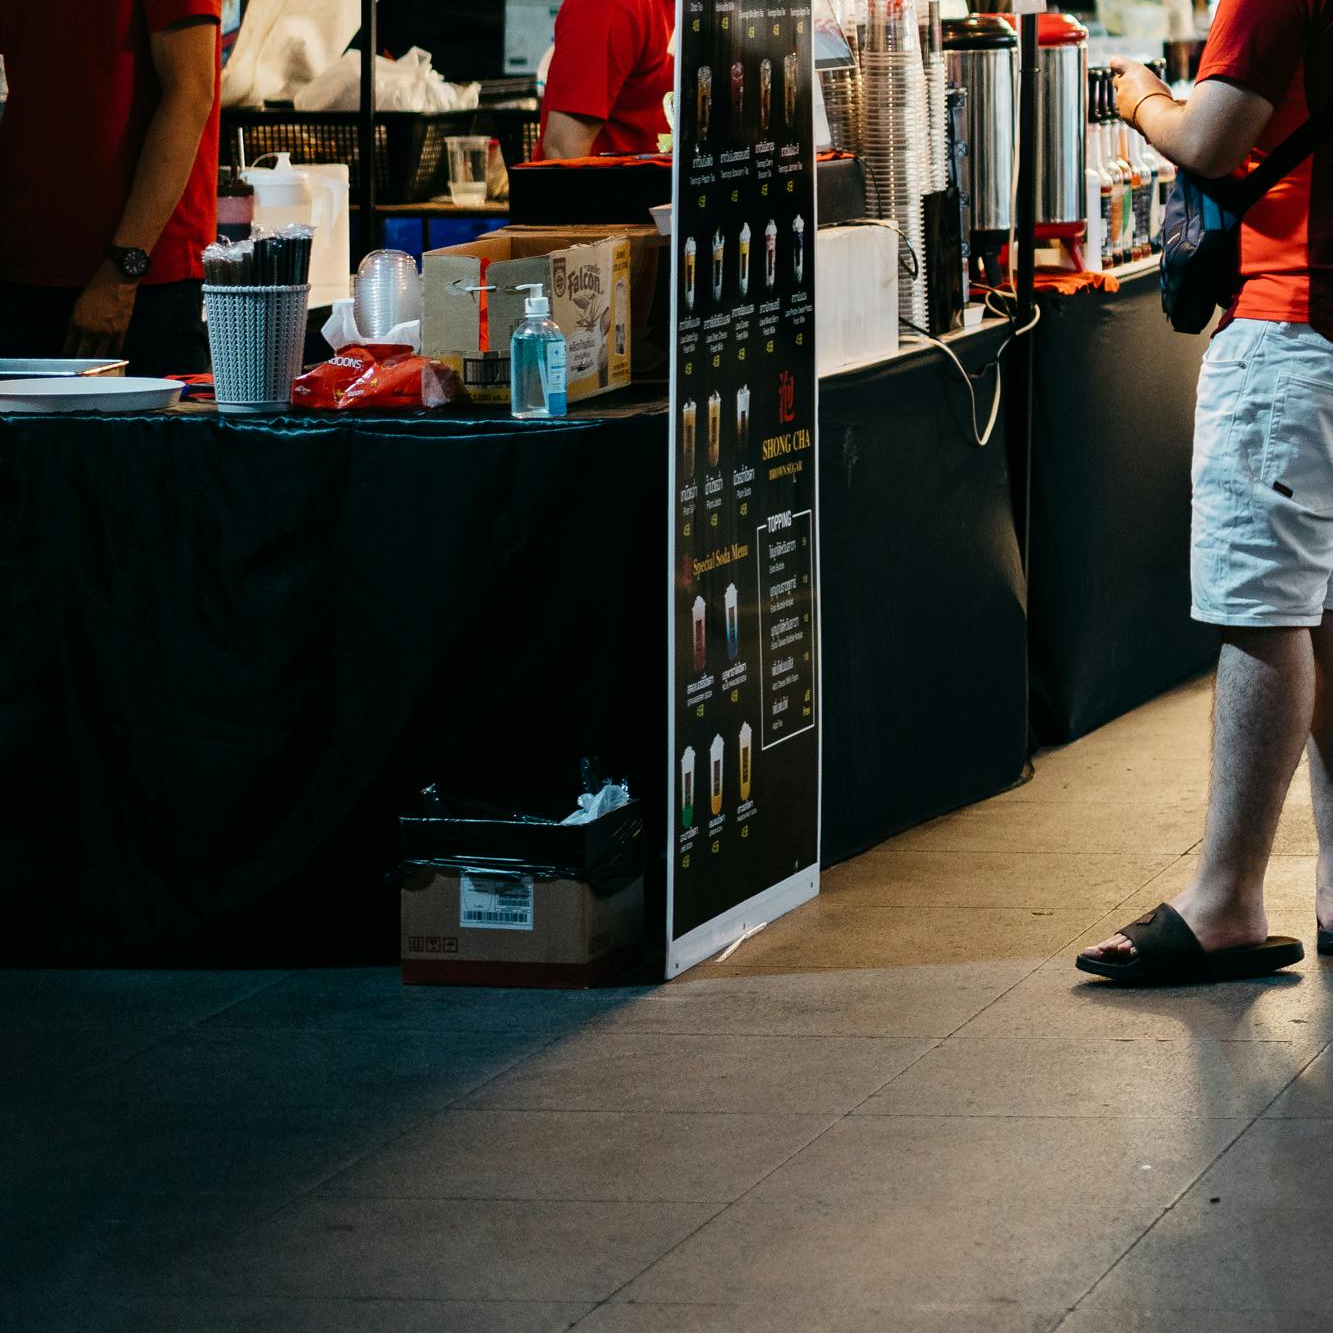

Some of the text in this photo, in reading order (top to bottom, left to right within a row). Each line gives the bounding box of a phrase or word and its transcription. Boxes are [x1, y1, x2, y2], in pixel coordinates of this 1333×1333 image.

[567, 267, 601, 302] Falcon
[763, 429, 811, 460] SHONG CHA
[767, 510, 792, 534] TOPPING
[693, 551, 715, 581] Special
[715, 546, 731, 567] Soda
